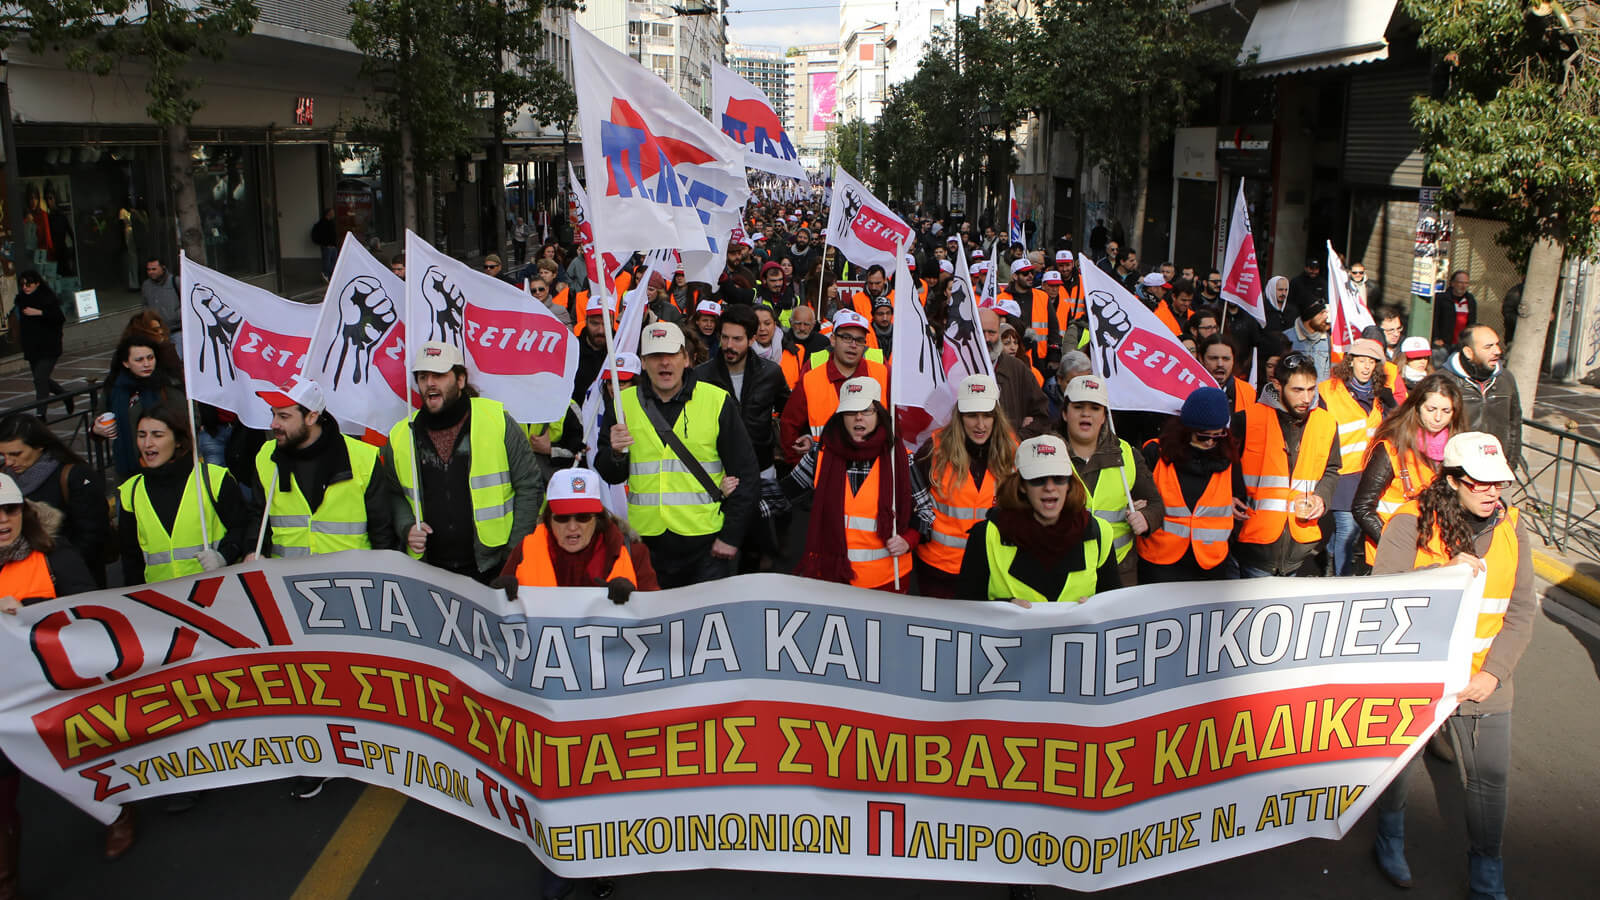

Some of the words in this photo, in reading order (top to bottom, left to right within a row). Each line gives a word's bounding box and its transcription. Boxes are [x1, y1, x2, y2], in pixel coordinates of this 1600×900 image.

[857, 213, 904, 243] ΣΕΤΗΠ
[240, 332, 306, 369] ΣΕΤ
[467, 320, 562, 353] ΣΕΤΗΠ
[30, 570, 293, 690] ΟΧΙ
[294, 578, 422, 638] ΣΤΑ
[428, 589, 741, 692] ΧΑΡΑΤΣΙΑ
[764, 608, 881, 684] ΚΑΙ
[907, 624, 1022, 696] ΤΙΣ
[1049, 597, 1430, 697] ΠΕΡΙΚΟΠΕΣ
[64, 663, 341, 759] ΑΥΞΗΣΕΙΣ
[350, 665, 455, 735] ΣΤΙΣ
[462, 695, 757, 788] ΣΥΝΤΑΞΕΙΣ
[778, 717, 1136, 799] ΣΥΜΒΑΣΕΙΣ
[1152, 698, 1432, 786] ΚΛΑΔΙΚΕΣ
[79, 735, 322, 801] ΣΥΝΔΙΚΑΤΟ
[867, 800, 1201, 875] ΠΛΗΡΟΦΟΡΙΚΗΣ
[1211, 803, 1245, 842] Ν.
[1255, 785, 1367, 832] ΑΤΤΙΚ
